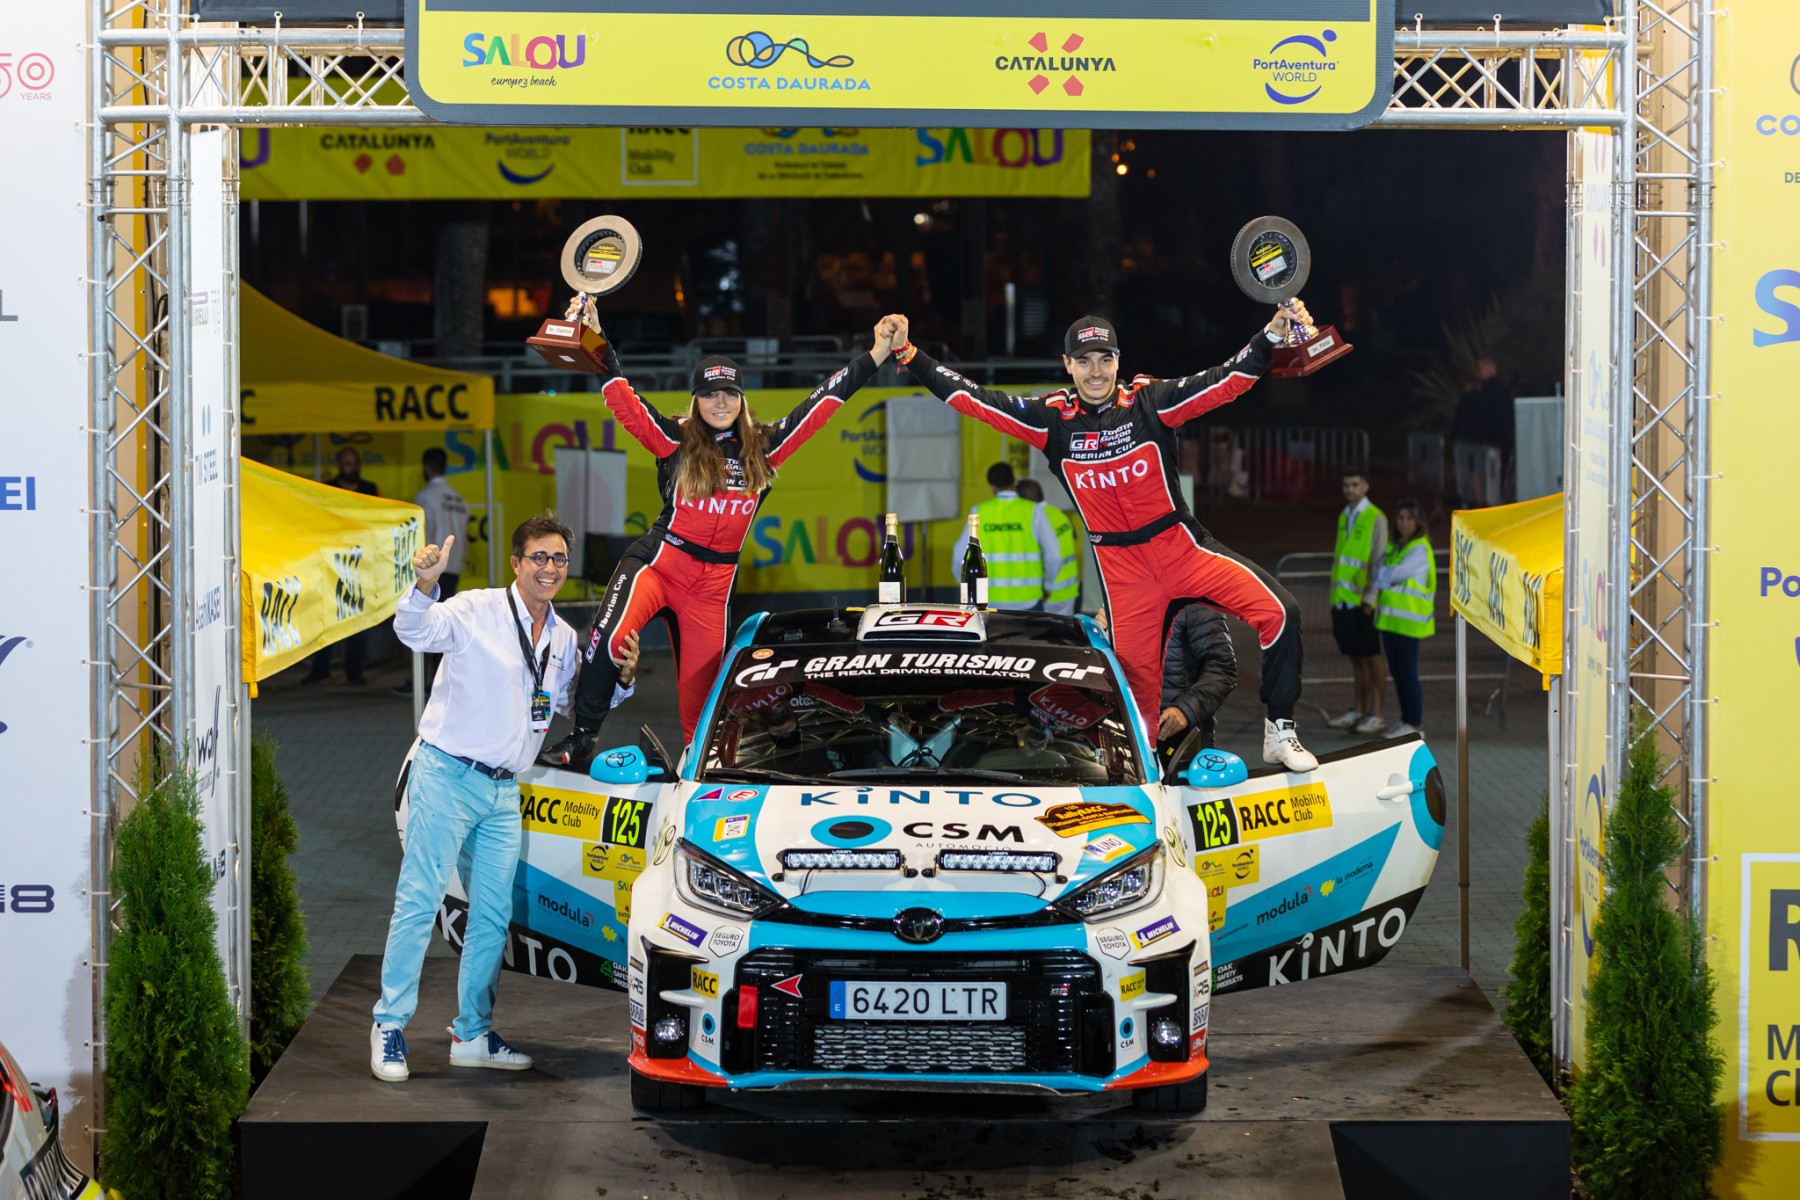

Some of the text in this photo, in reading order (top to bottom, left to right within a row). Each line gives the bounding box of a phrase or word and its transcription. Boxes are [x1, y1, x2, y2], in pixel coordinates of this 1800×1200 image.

[462, 32, 586, 70] SALOU
[995, 55, 1116, 72] CATALUNYA
[1253, 58, 1337, 72] PortAventura
[530, 75, 557, 87] beach
[708, 76, 872, 91] COSTA DAURADA
[1272, 72, 1317, 83] WORLD
[20, 92, 52, 100] YEARS
[320, 133, 436, 149] CATALUNYA
[374, 383, 469, 421] RACC
[1071, 440, 1136, 459] IBERIAN CUP
[983, 522, 1023, 533] CONTROL
[599, 573, 627, 629] Iberian Cup
[261, 575, 302, 657] RACC
[878, 611, 971, 628] GR
[804, 653, 1037, 673] GRAN TURISMO
[805, 667, 1031, 680] THE REAL DRIVING SIMULATOR
[1290, 793, 1326, 809] Mobility
[563, 800, 600, 820] Mobility
[1238, 799, 1290, 832] RACC
[1293, 808, 1313, 822] Club
[562, 814, 582, 828] Club
[611, 799, 645, 847] 125
[1196, 800, 1232, 849] 125
[902, 822, 1025, 843] CSM
[1344, 861, 1374, 881] moderna
[538, 893, 591, 928] modula
[1256, 891, 1309, 926] modula
[670, 920, 700, 940] MICHELIN
[714, 931, 740, 941] SEGURO
[1147, 920, 1174, 939] MICHELIN
[712, 938, 737, 948] TOYOTA
[1099, 933, 1125, 943] SEGURO
[1103, 941, 1128, 949] TOYOTA
[1217, 963, 1233, 974] OAK
[1217, 969, 1237, 982] SAFETY
[692, 972, 717, 995] RACC
[1120, 981, 1137, 995] RACC
[1216, 975, 1243, 990] PRODUCTS
[853, 987, 930, 1014] 6420
[942, 987, 998, 1014] LTR
[700, 1034, 714, 1045] CSM
[1120, 1039, 1134, 1049] CSM
